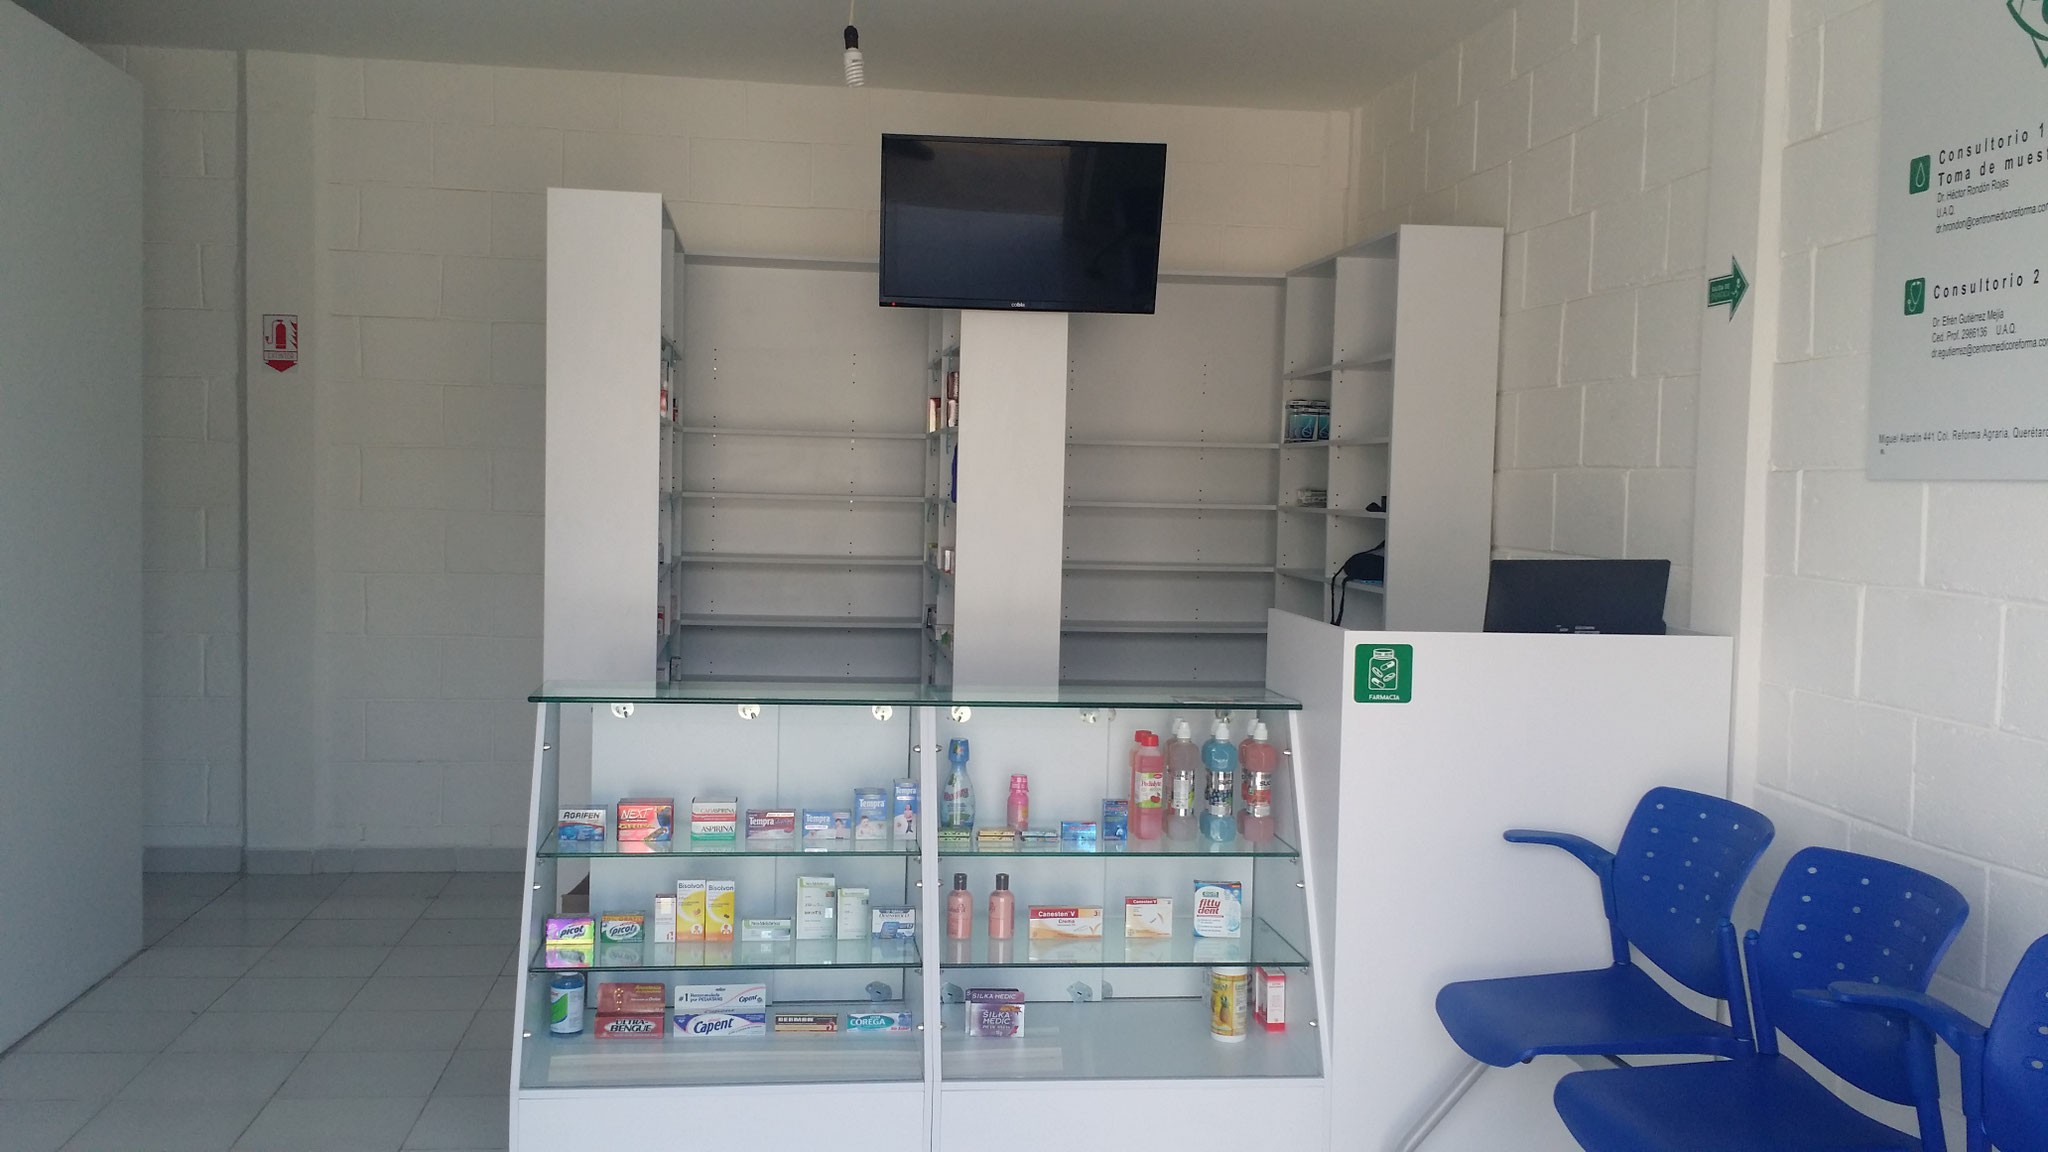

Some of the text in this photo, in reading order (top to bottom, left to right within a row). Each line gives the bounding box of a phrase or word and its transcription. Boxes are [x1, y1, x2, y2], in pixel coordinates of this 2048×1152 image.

[1939, 122, 2045, 165] Consultorio 1
[1938, 168, 1971, 187] Toma
[1979, 161, 1995, 176] de
[1933, 268, 2040, 300] Consultorio 2
[1952, 429, 1981, 441] Reforma
[895, 786, 917, 795] Tempra
[858, 798, 886, 809] Tempra
[620, 807, 654, 820] NEXT
[805, 813, 831, 824] Tempra
[748, 816, 775, 827] Tempra
[701, 825, 734, 833] ASPIRINA
[1199, 898, 1221, 908] fitty
[1197, 907, 1220, 915] dent
[560, 925, 585, 939] picot
[611, 924, 634, 937] picot
[738, 994, 758, 1004] Capent
[849, 1018, 886, 1026] COREGA
[982, 1017, 1011, 1025] MEDIC
[693, 1018, 735, 1036] Capent
